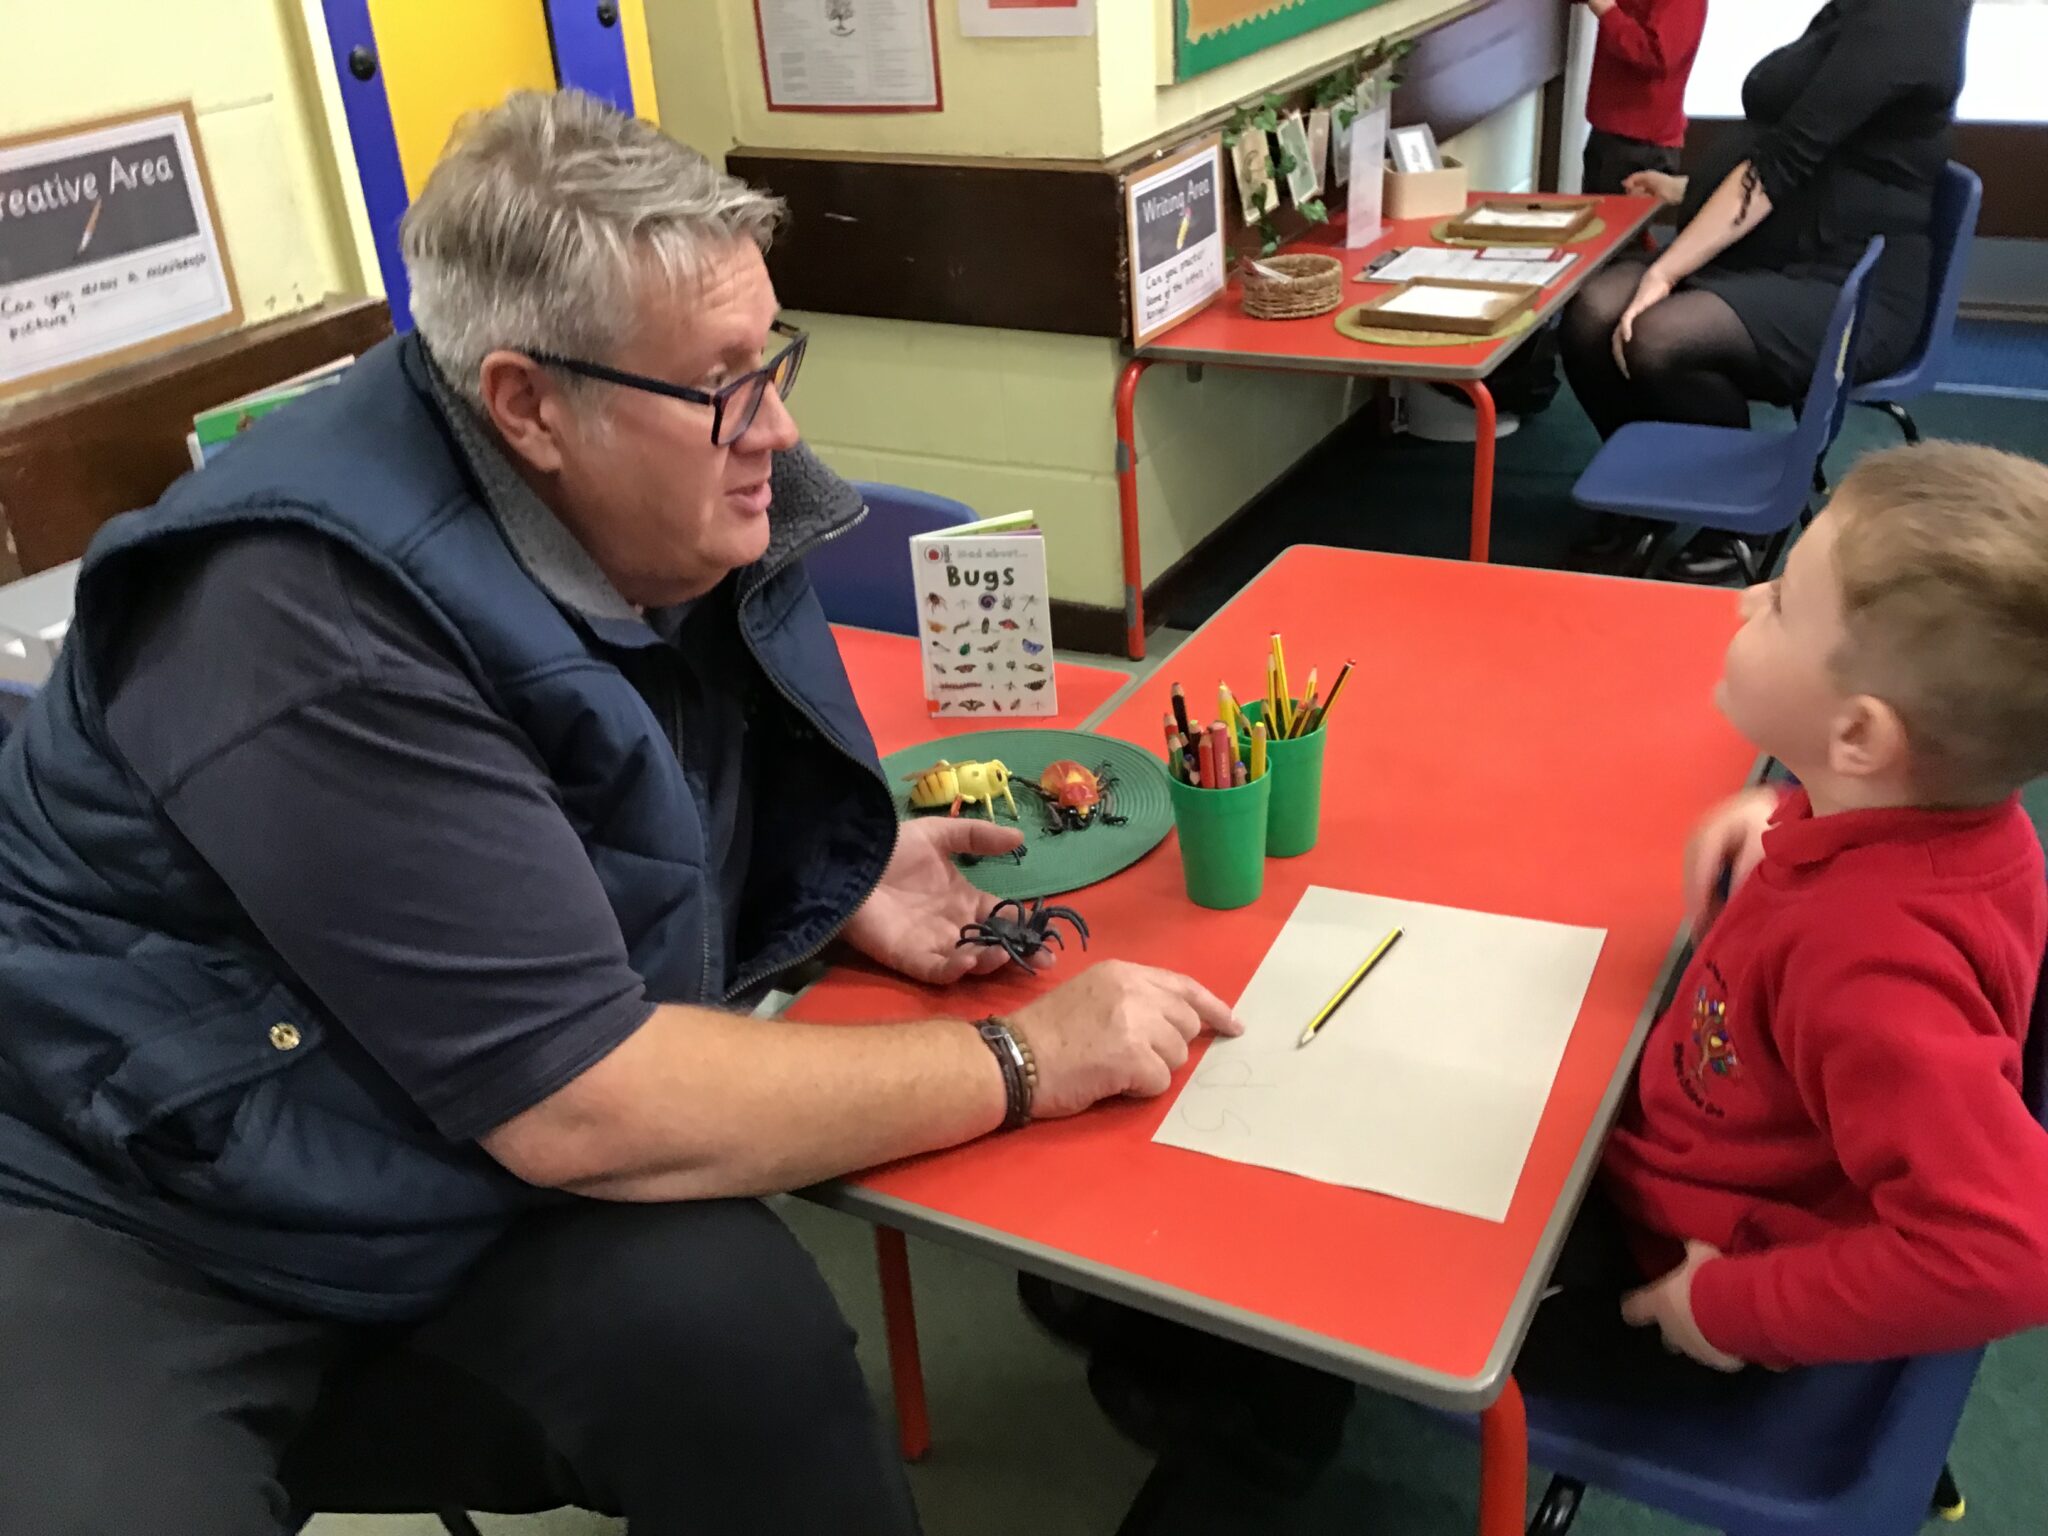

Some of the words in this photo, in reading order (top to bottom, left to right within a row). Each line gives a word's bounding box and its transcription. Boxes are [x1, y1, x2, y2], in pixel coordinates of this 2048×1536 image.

[0, 172, 99, 221] reative
[110, 155, 174, 195] Area
[1142, 191, 1185, 223] Writing
[1187, 178, 1210, 204] Area
[946, 564, 1015, 592] Bugs
